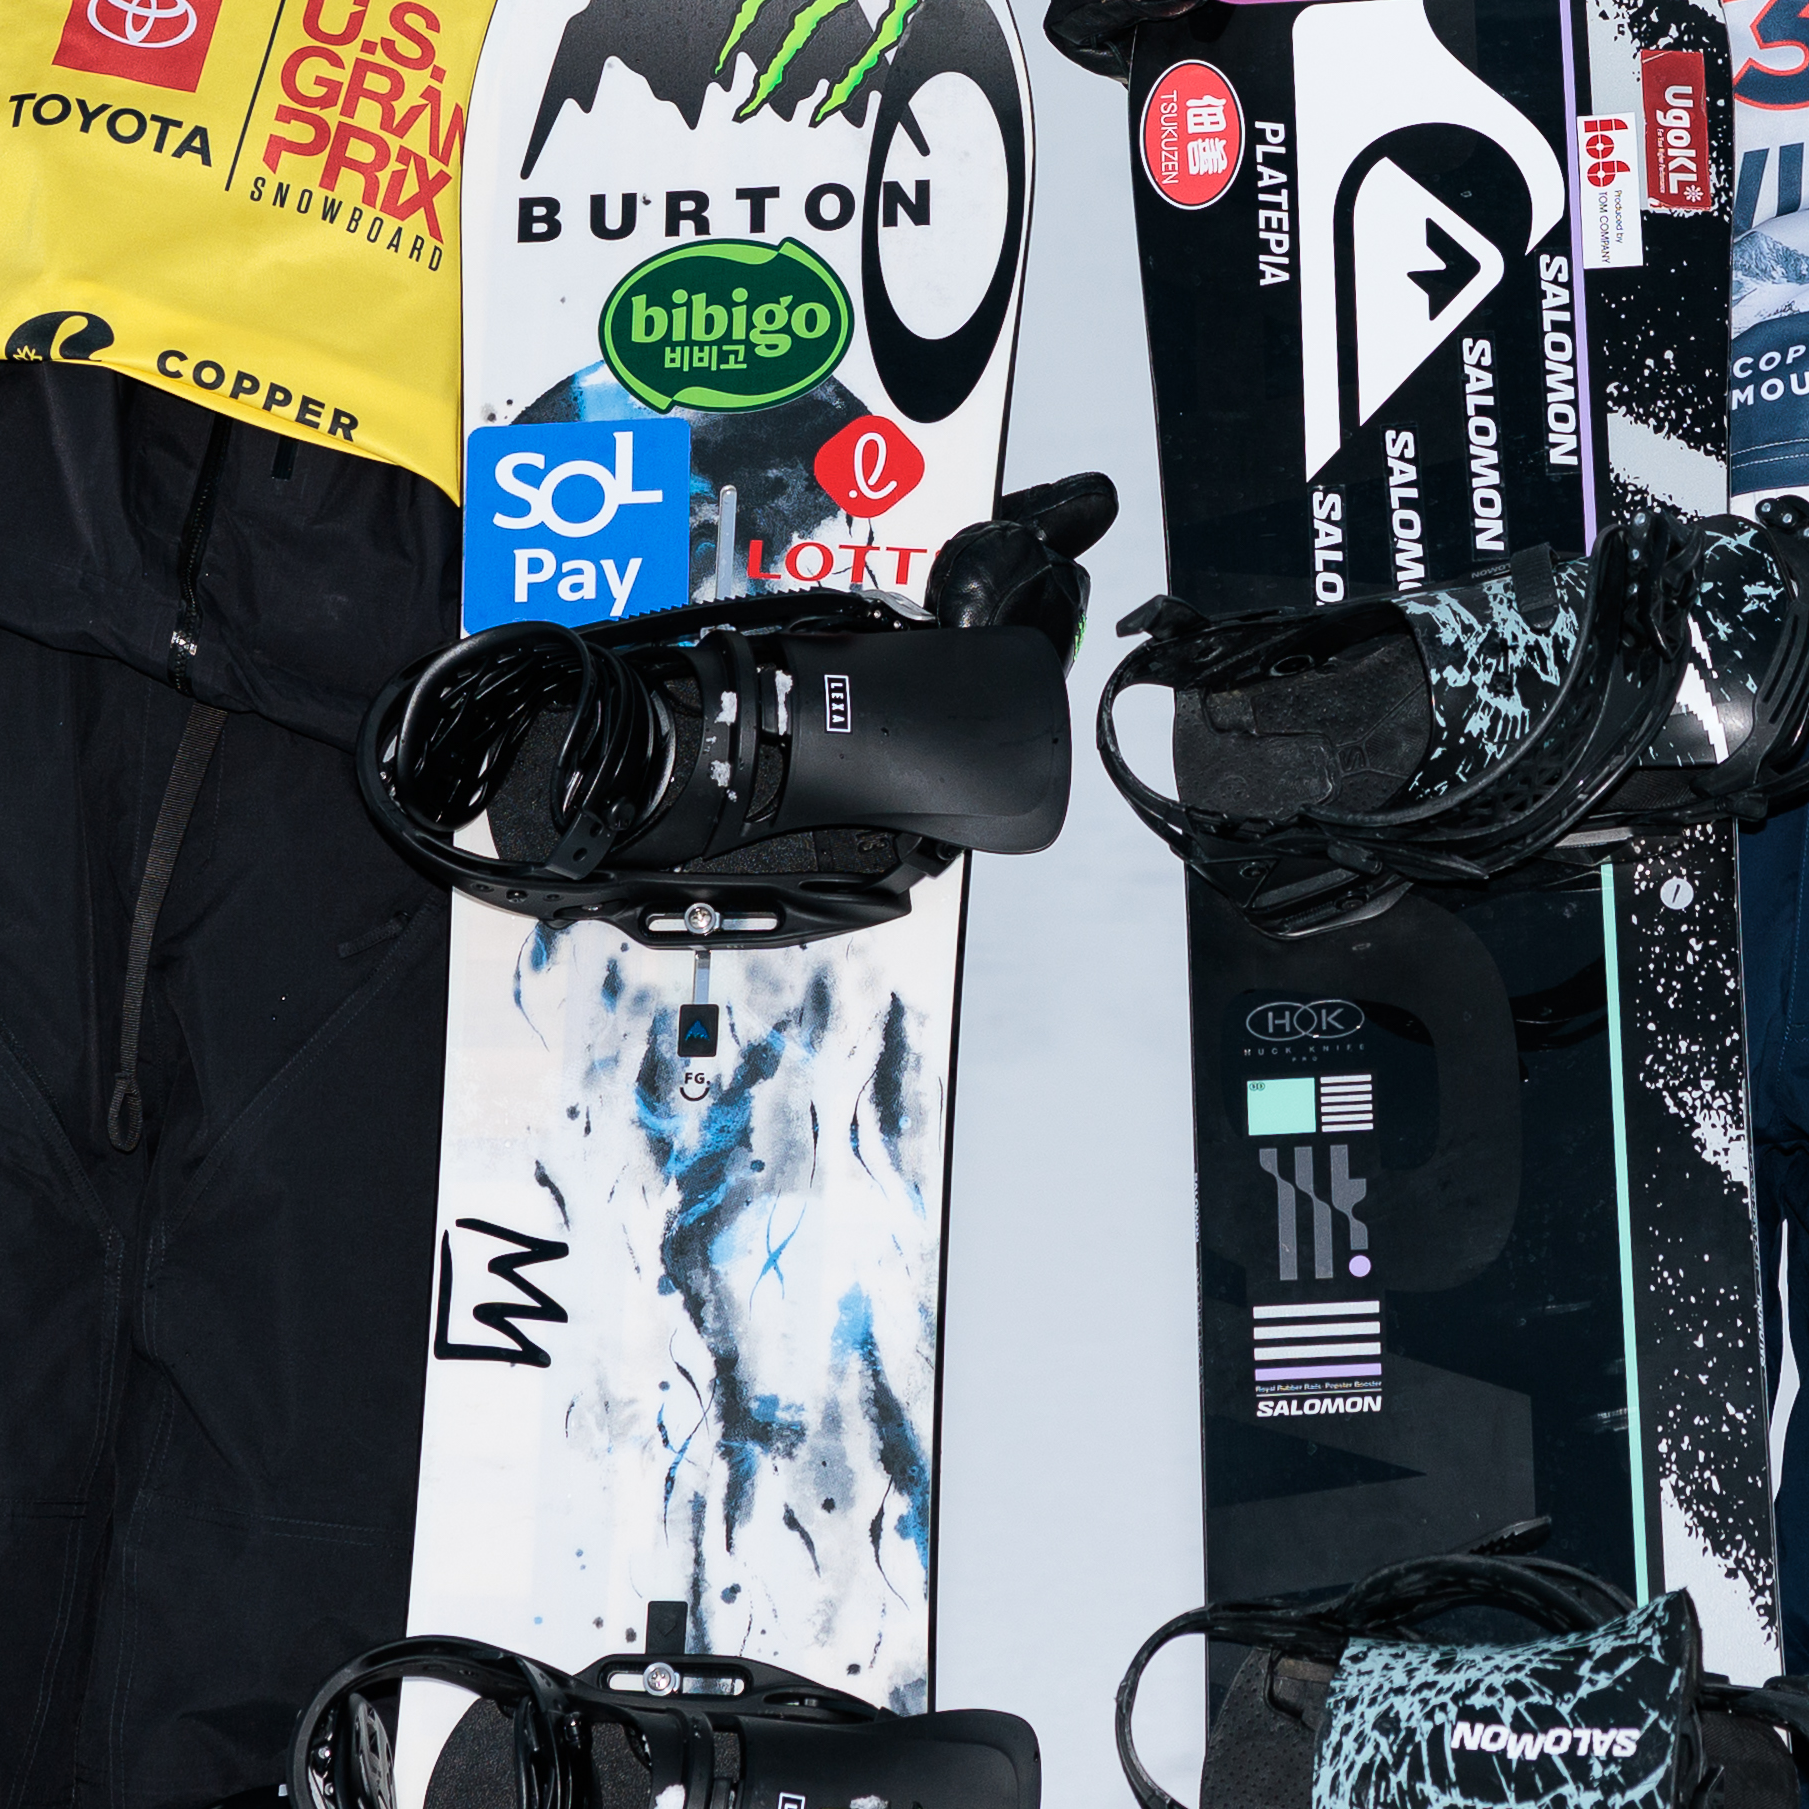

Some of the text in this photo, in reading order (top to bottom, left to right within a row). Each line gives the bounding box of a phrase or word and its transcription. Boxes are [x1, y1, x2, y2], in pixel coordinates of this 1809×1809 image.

[9, 92, 213, 168] TOYOTA
[280, 45, 464, 167] GRA
[1160, 90, 1179, 185] TSUKUZEN
[262, 104, 453, 245] PRIX
[517, 179, 932, 243] BURTON
[1255, 121, 1291, 287] PLATEPIA
[250, 176, 443, 271] SNOWBOARD
[1598, 192, 1611, 263] TOM COMPANY
[1614, 190, 1624, 244] Produced by
[631, 287, 831, 358] bibigo
[664, 346, 747, 371] 비비고
[156, 348, 360, 442] COPPER
[1540, 253, 1579, 466] SALOMON
[1462, 337, 1505, 551] SALOMON
[1385, 429, 1426, 592] SALOM
[513, 549, 643, 617] Pay
[748, 540, 941, 585] LOTT
[1312, 491, 1346, 606] SALO
[831, 682, 845, 723] LEXA
[1243, 1043, 1365, 1056] HUCK KNIFE
[1256, 1396, 1382, 1418] SALOMON
[1451, 1721, 1641, 1760] SALOMON
